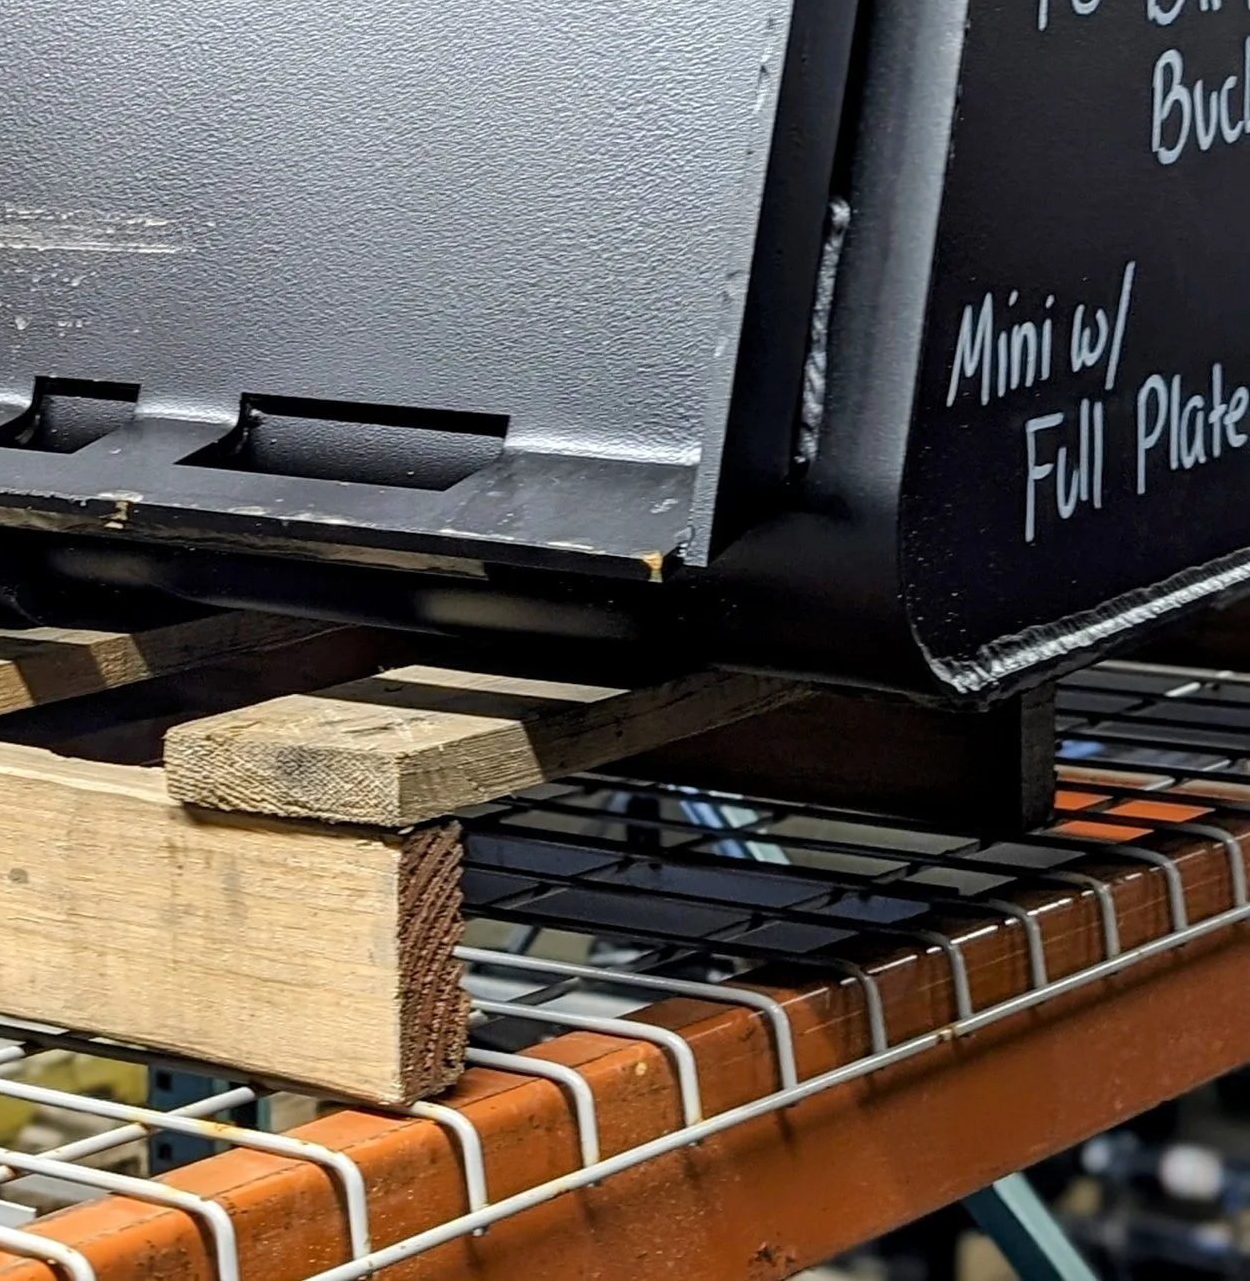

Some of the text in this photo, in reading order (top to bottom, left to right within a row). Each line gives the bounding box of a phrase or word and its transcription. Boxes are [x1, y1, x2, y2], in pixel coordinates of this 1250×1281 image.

[1152, 35, 1250, 166] Buc
[946, 260, 1137, 408] Mini w/
[1025, 362, 1250, 543] Full Plate
